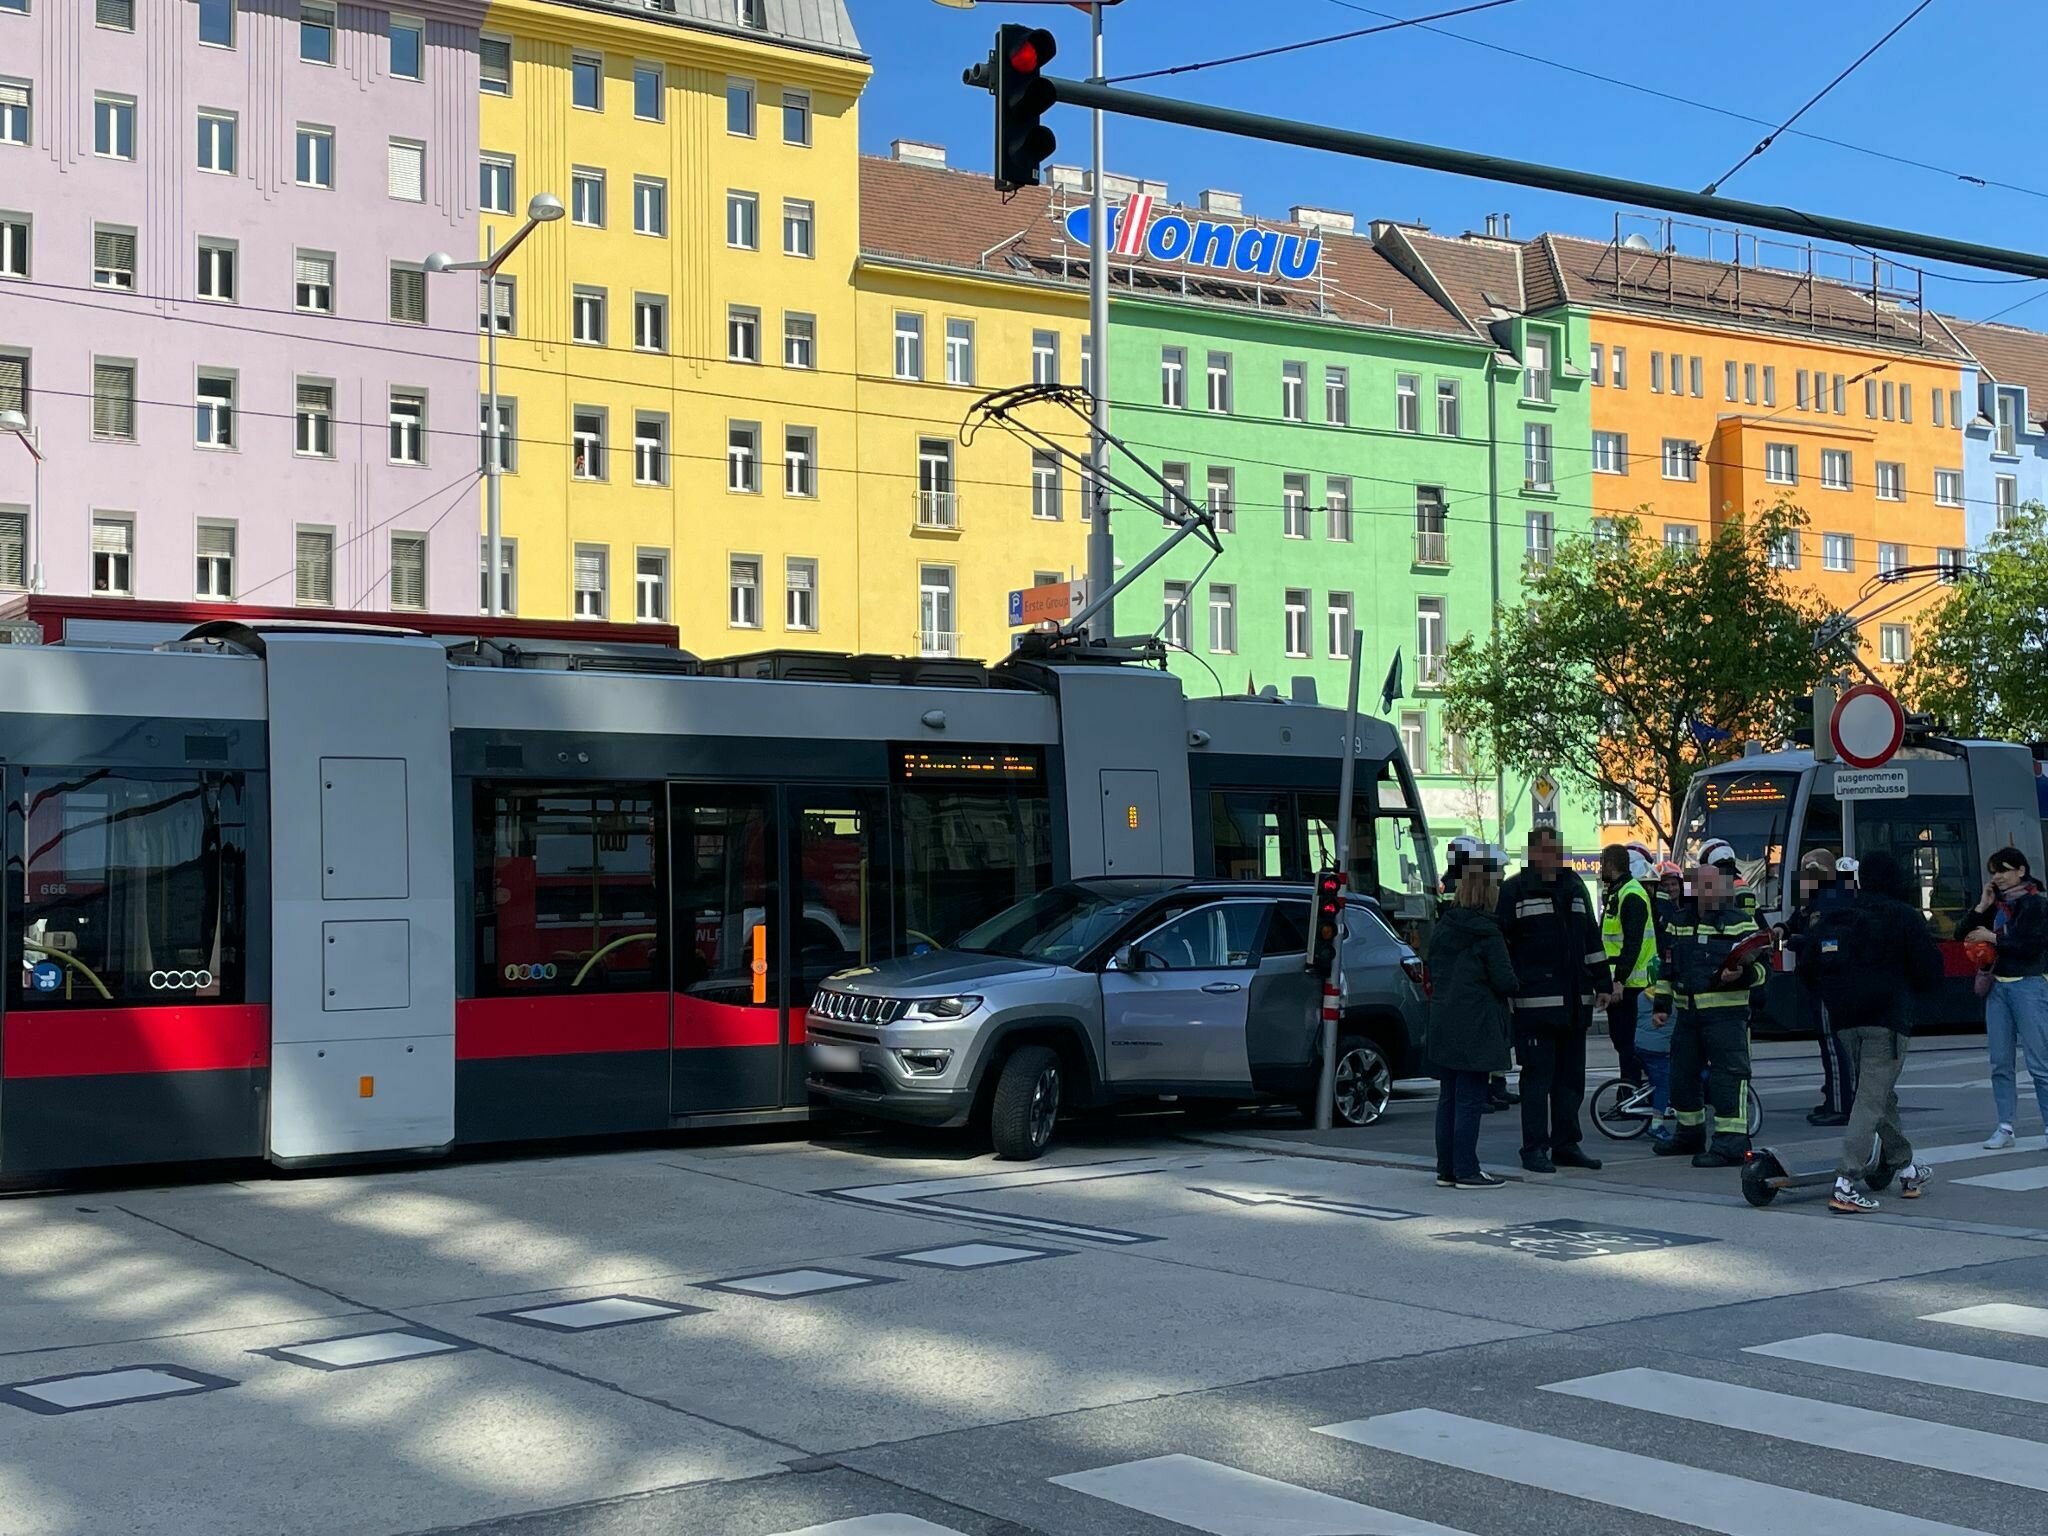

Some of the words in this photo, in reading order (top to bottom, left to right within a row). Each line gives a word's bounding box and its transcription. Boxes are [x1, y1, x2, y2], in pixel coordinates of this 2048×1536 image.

[1024, 600, 1044, 613] Erste
[1045, 596, 1069, 610] Group
[1837, 772, 1904, 784] ausgenommen
[1836, 784, 1906, 795] Linienomnibusse
[40, 883, 67, 895] 666
